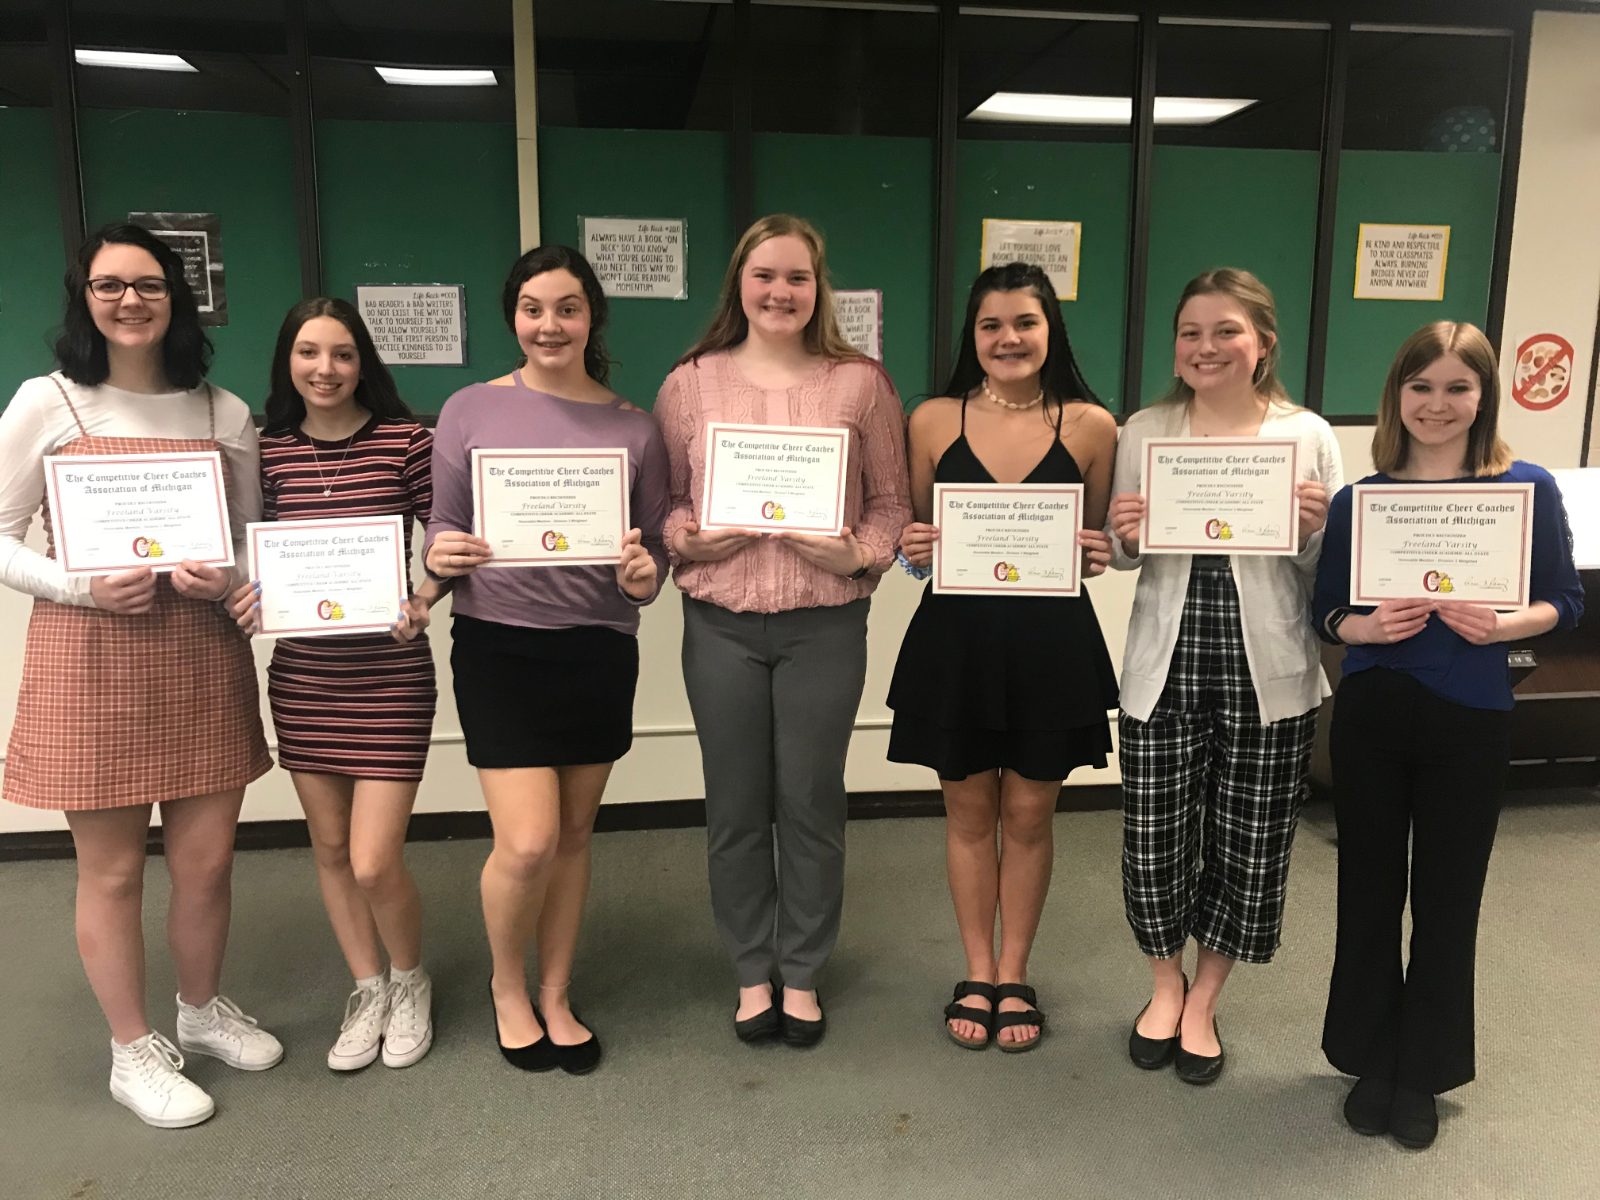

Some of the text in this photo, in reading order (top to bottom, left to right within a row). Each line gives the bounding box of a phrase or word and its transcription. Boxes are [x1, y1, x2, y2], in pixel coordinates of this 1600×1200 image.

[591, 234, 616, 242] ALWAYS
[619, 234, 635, 242] HAVE
[645, 235, 662, 243] BOOK
[622, 244, 630, 252] SO
[633, 244, 645, 252] YOU
[648, 245, 668, 253] KNOW
[1045, 244, 1061, 252] LOVE
[1366, 240, 1371, 248] BE
[1374, 240, 1390, 248] KIND
[596, 253, 614, 261] WHAT
[618, 254, 638, 262] YOU'RE
[1018, 253, 1045, 262] READING
[1048, 254, 1055, 262] IS
[1370, 250, 1377, 258] TO
[592, 263, 607, 271] READ
[632, 264, 647, 272] THIS
[1401, 261, 1427, 269] BURNING
[642, 274, 670, 282] READING
[1371, 269, 1429, 278] BRIDGES NEVER GOT
[1370, 279, 1392, 287] ANYONE
[721, 440, 835, 453] The Competitive Cheer Coaches
[734, 452, 775, 461] Association
[786, 455, 820, 464] Michigan
[1158, 455, 1285, 464] The Competitive Cheer Coaches
[508, 467, 554, 475] Competitive
[557, 467, 579, 475] Cheer
[582, 467, 614, 475] Coaches
[1172, 467, 1269, 476] Association of Michigan
[65, 471, 206, 482] The Competitive Cheer Coaches
[504, 479, 600, 487] Association of Michigan
[84, 485, 137, 494] Association
[151, 483, 192, 492] Michigan
[521, 502, 586, 510] Freeland Varsity
[949, 501, 1068, 510] The Competitive Cheer Coaches
[1370, 504, 1515, 513] The Competitive Cheer Coaches
[962, 512, 1006, 520] Association
[1017, 513, 1054, 521] Michigan
[1386, 516, 1496, 526] Association of Michigan
[264, 540, 280, 548] The
[282, 539, 328, 547] Competitive
[1402, 540, 1478, 549] Freeland Varsity
[280, 551, 325, 559] Association
[338, 548, 375, 556] Michigan
